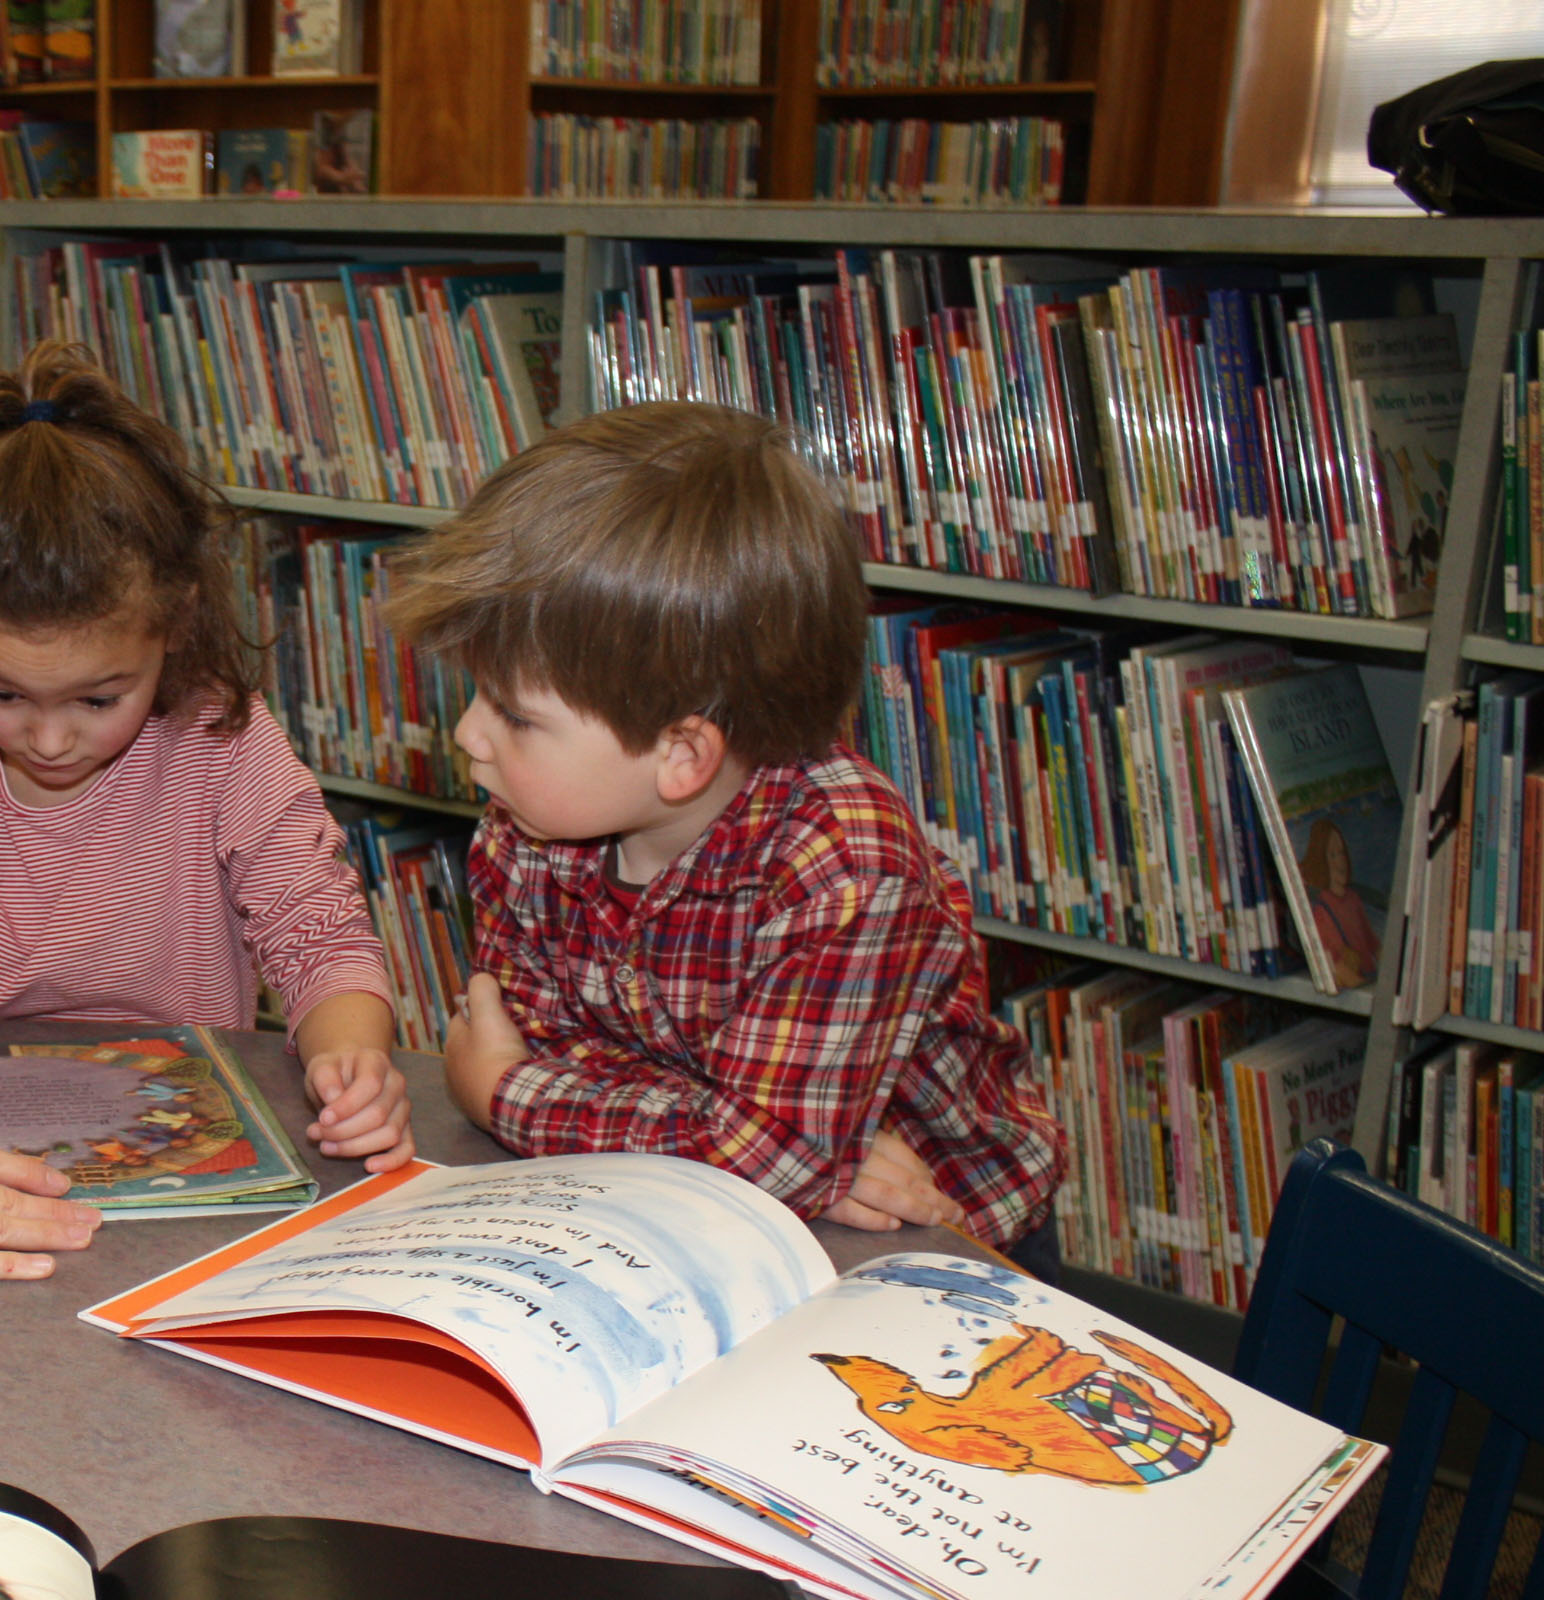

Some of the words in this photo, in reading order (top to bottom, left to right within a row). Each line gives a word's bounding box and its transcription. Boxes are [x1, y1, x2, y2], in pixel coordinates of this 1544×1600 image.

[144, 151, 187, 168] Than
[149, 170, 185, 184] One
[1289, 718, 1352, 753] ISLAND
[1281, 1071, 1301, 1095] No
[1302, 1058, 1336, 1085] More
[453, 1217, 478, 1227] to
[486, 1217, 555, 1231] mean
[400, 1231, 451, 1243] have
[453, 1232, 503, 1242] even
[564, 1227, 591, 1242] I'm
[408, 1247, 447, 1260] silly
[453, 1252, 473, 1264] a
[506, 1234, 567, 1260] don't
[596, 1242, 651, 1270] And
[477, 1253, 533, 1275] just
[572, 1258, 594, 1269] I
[409, 1271, 439, 1280] at
[533, 1270, 567, 1290] I'm
[450, 1274, 541, 1318] horrible
[549, 1320, 582, 1353] I'm
[789, 1439, 861, 1475] best
[838, 1428, 983, 1506] anything.
[873, 1472, 922, 1506] the
[862, 1494, 930, 1538] dear.
[928, 1507, 983, 1540] not
[993, 1510, 1032, 1533] at
[938, 1536, 988, 1577] Oh,
[996, 1541, 1043, 1575] I'm
